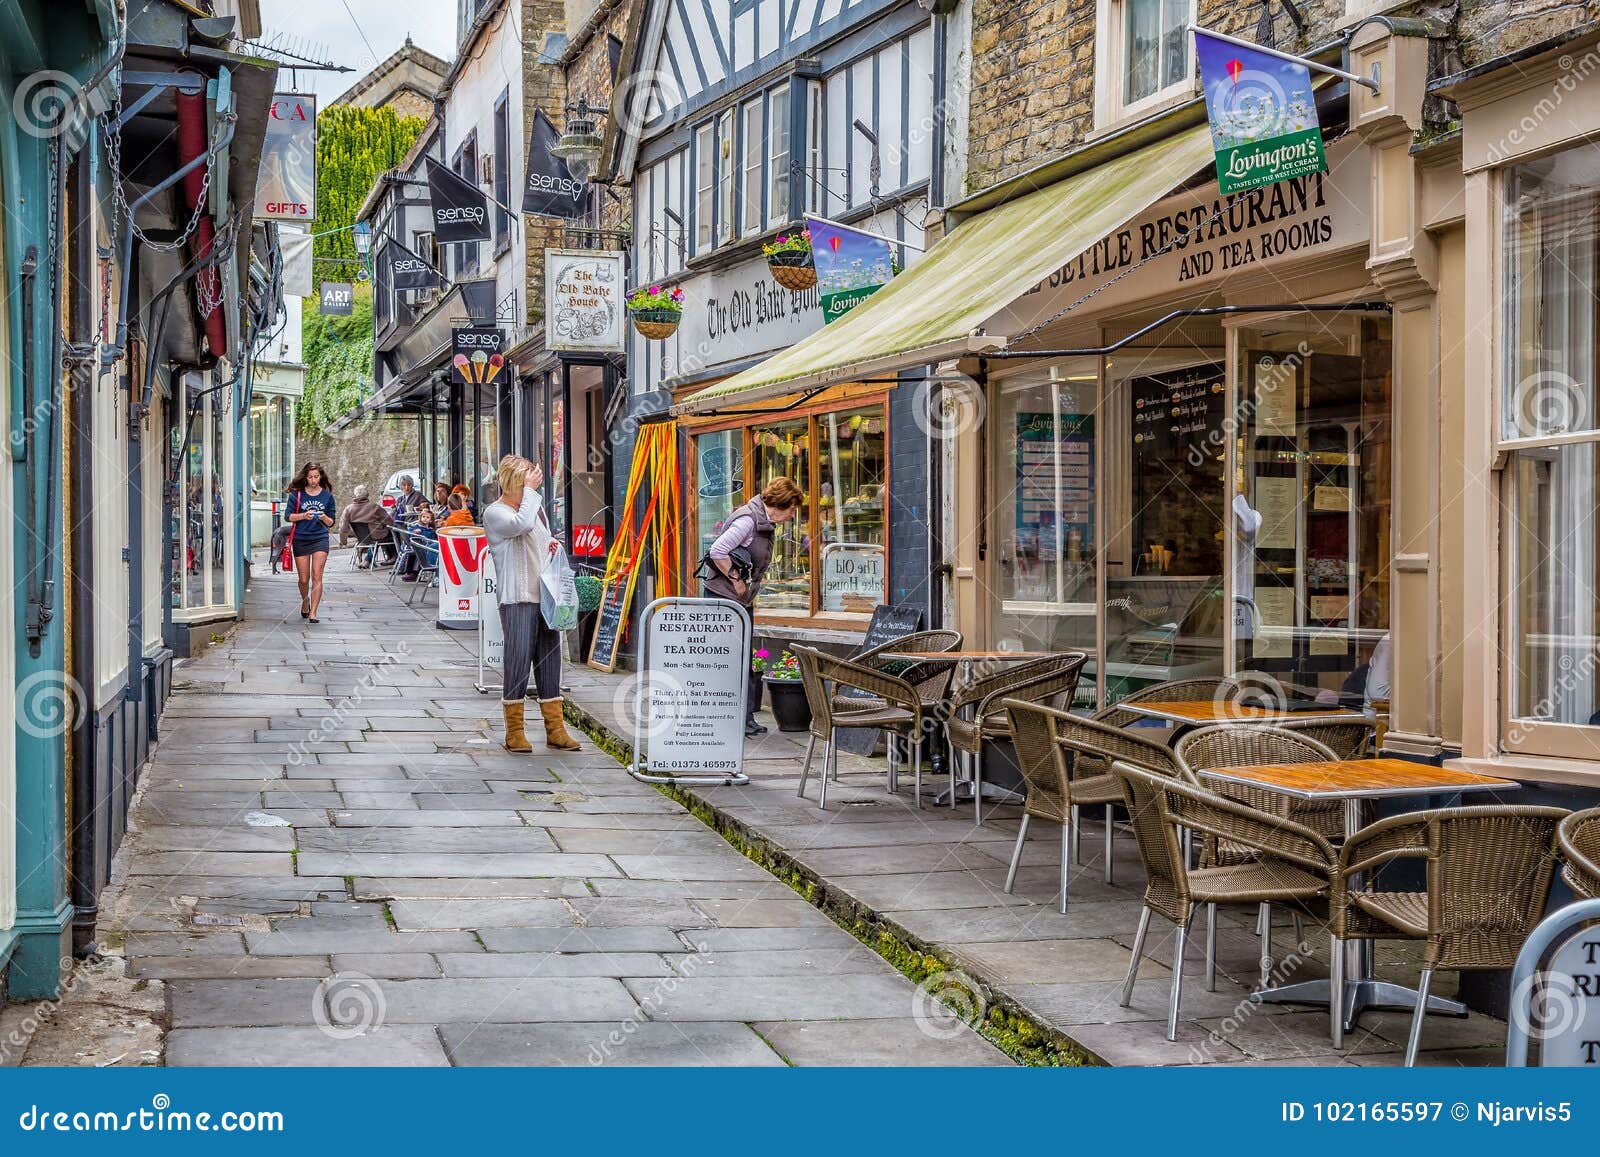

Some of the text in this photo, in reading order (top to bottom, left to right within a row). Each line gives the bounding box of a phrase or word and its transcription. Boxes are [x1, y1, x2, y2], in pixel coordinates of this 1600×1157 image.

[1225, 138, 1317, 178] Lovington's
[1282, 156, 1319, 170] ICE CREAM
[1233, 179, 1252, 189] TASTE
[1262, 175, 1274, 183] THE
[1274, 171, 1290, 180] WEST
[1290, 163, 1320, 175] COUNTRY
[266, 203, 307, 215] GIFTS
[1140, 170, 1329, 260] RESTAURANT
[1178, 215, 1333, 282] AND TEA ROOMS
[395, 260, 433, 274] sens
[574, 270, 592, 282] The
[324, 290, 350, 302] ART
[559, 284, 611, 297] Old Bake
[567, 296, 598, 309] House
[828, 294, 870, 314] Lovin
[707, 298, 727, 343] The
[730, 290, 751, 333] Old
[755, 280, 785, 332] Bake
[575, 528, 603, 552] illy
[663, 613, 732, 622] THE SETTLE
[659, 624, 734, 633] RESTAURANT
[687, 636, 706, 644] and
[664, 646, 730, 655] TEA ROOMS
[696, 662, 729, 670] 9am-5pm
[686, 680, 705, 688] Open
[704, 690, 737, 699] Evenings.
[652, 760, 737, 769] Tel: 01373 465975
